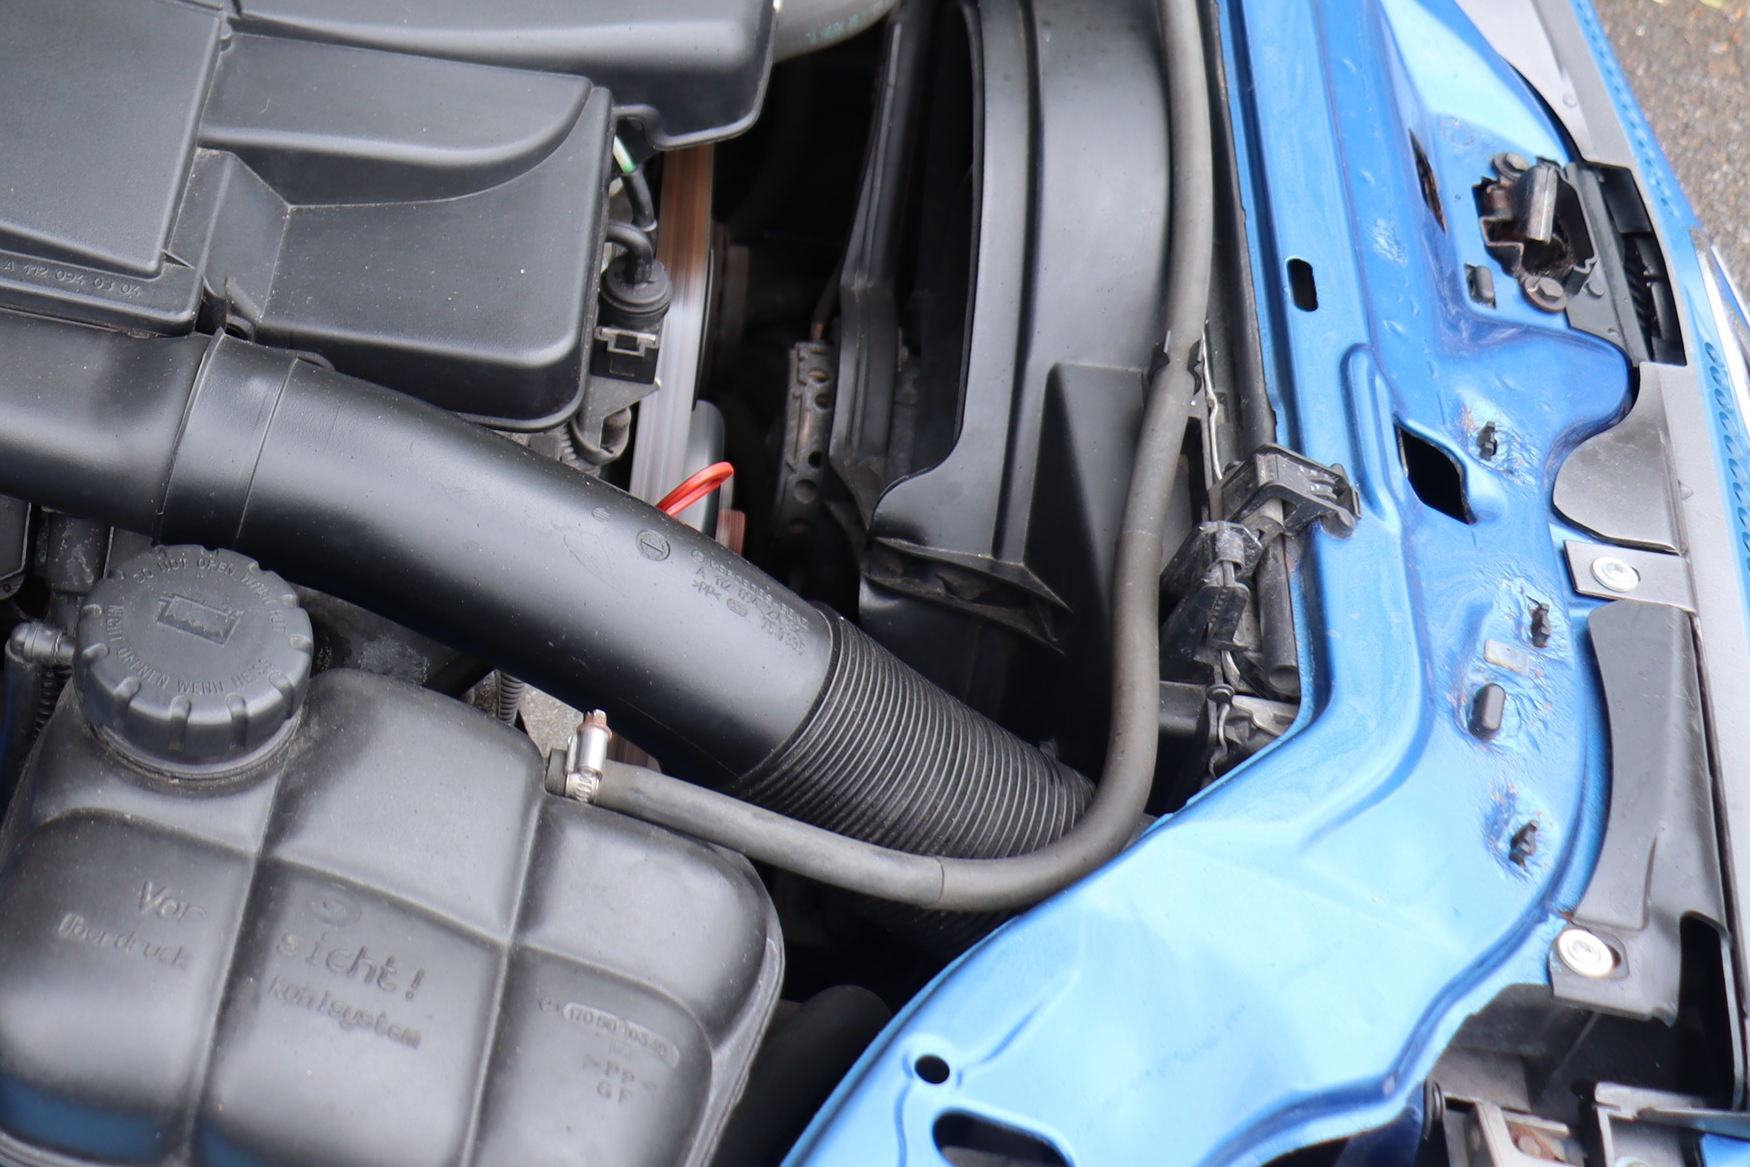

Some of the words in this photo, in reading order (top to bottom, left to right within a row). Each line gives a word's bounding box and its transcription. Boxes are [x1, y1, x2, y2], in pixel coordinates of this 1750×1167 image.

[3, 261, 15, 272] A
[23, 264, 48, 277] 112
[55, 269, 84, 284] 094
[93, 277, 114, 291] 03
[120, 283, 142, 297] 04
[196, 558, 237, 577] OPEN
[696, 566, 706, 579] A
[107, 604, 124, 642] NICHT
[177, 680, 223, 694] WENN
[138, 880, 207, 923] Vor
[275, 932, 425, 1002] sicht!
